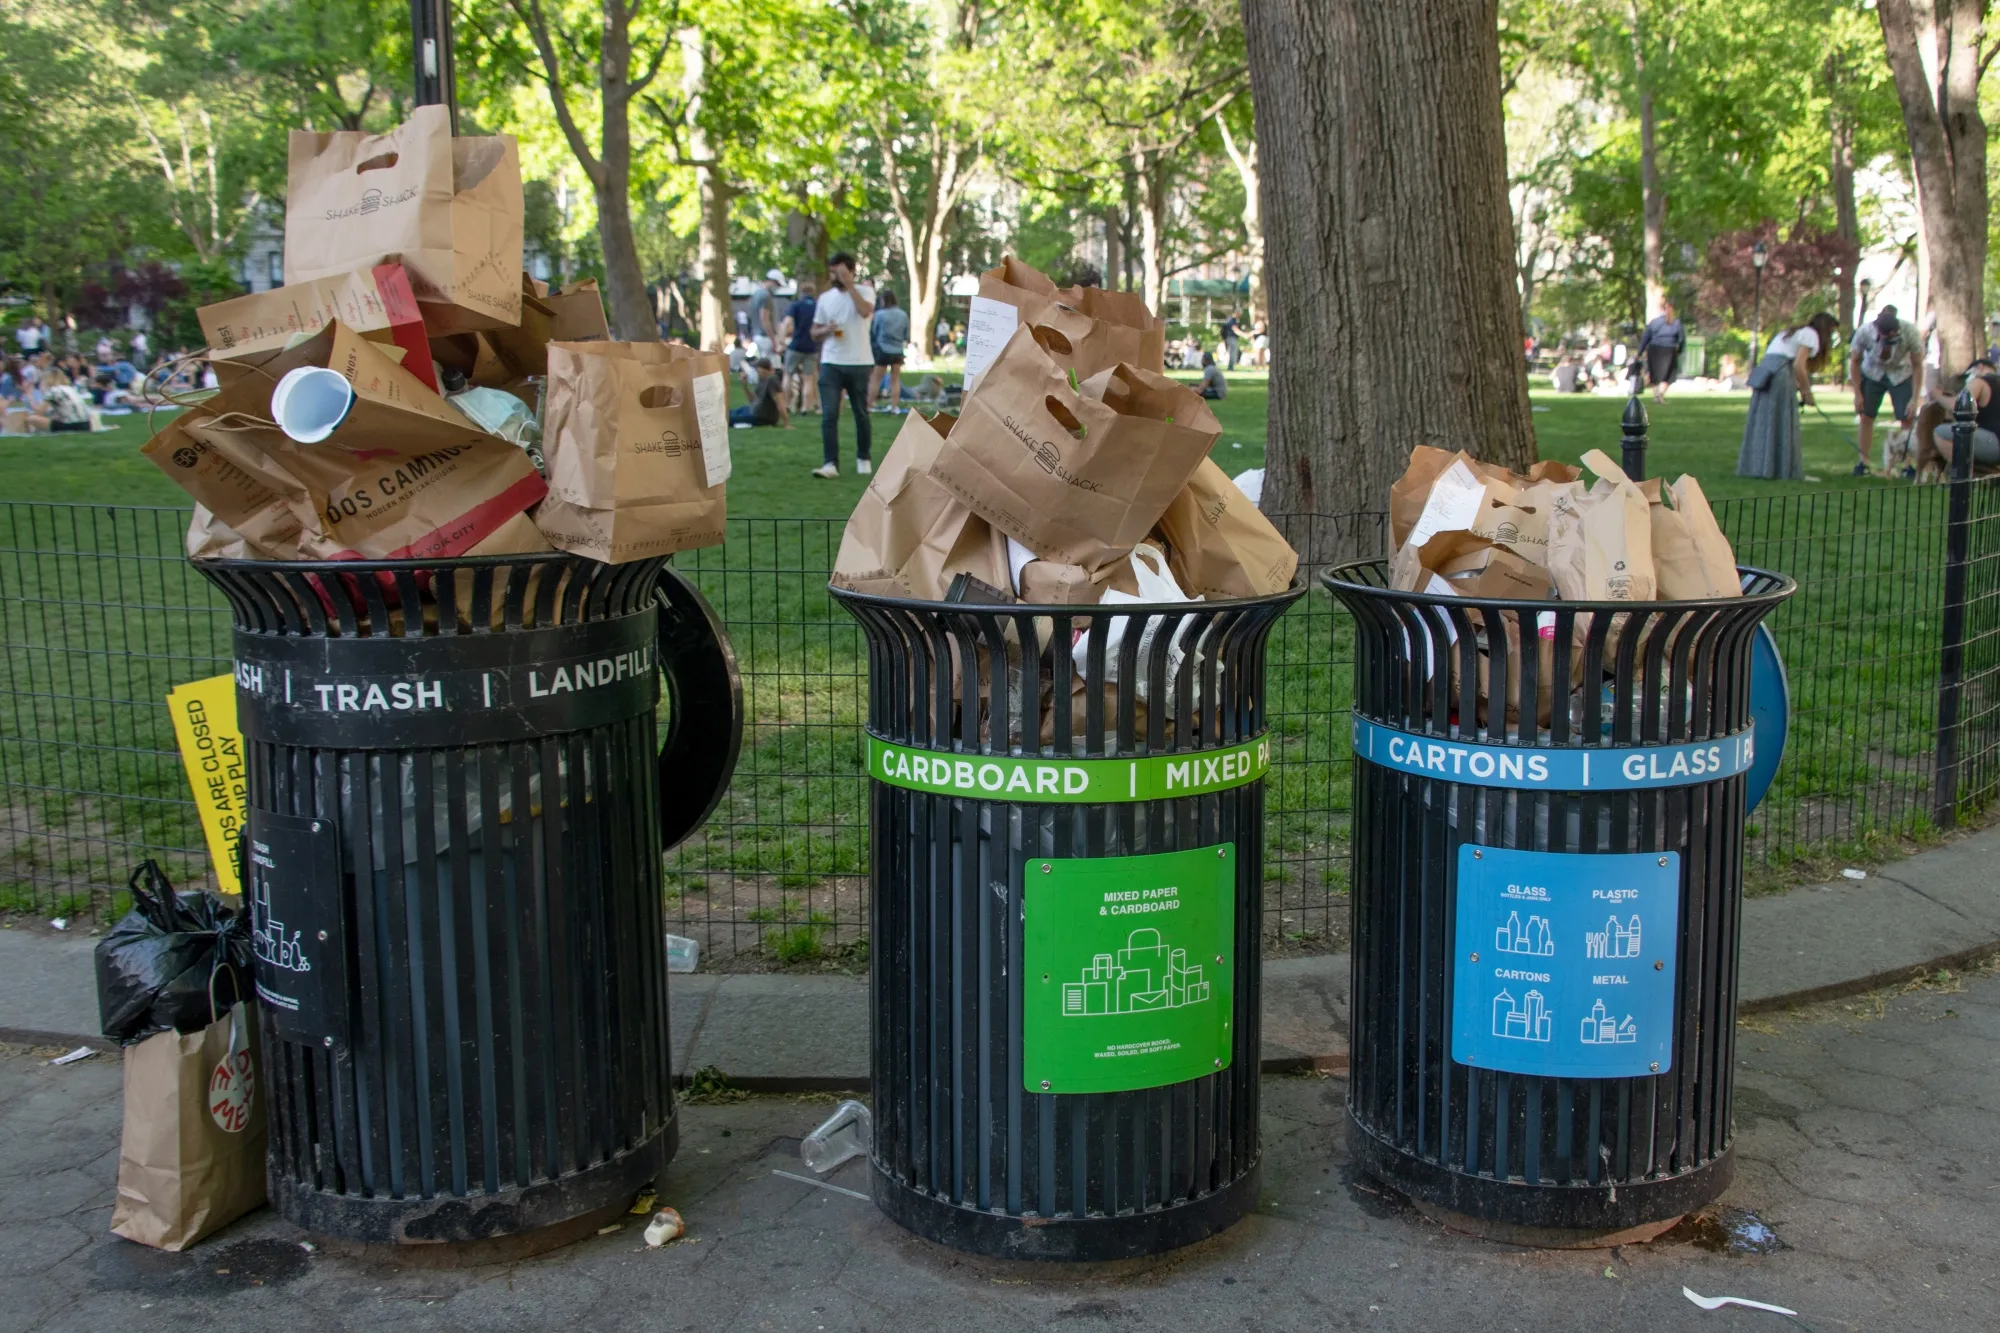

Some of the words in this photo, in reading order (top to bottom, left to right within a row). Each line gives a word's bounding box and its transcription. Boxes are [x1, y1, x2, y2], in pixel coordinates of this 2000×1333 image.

[324, 207, 360, 221] SHAKE
[381, 188, 418, 208] SHACK
[634, 441, 663, 454] SHAKE
[681, 440, 701, 452] SHA
[1003, 415, 1039, 453] SHAKE
[1055, 466, 1100, 493] SHACK
[326, 489, 373, 525] DOS
[366, 501, 397, 520] MODERN
[398, 481, 430, 502] MEXICAN
[429, 463, 458, 485] CUISINE
[426, 537, 451, 554] YORK
[452, 523, 477, 541] CITY
[541, 529, 564, 543] HAKE
[565, 534, 600, 549] SHACK
[1473, 530, 1495, 539] AKE
[1519, 535, 1549, 547] SHAC
[235, 659, 263, 694] ASH
[314, 680, 444, 712] TRASH
[529, 648, 652, 698] LANDFILL
[186, 699, 219, 773] CLOSED
[218, 736, 247, 779] PLAY
[882, 749, 1090, 795] CARDBOARD
[1165, 750, 1250, 790] MIXED
[1388, 737, 1549, 782] CARTONS
[1622, 746, 1720, 782] GLASS
[206, 774, 233, 812] ARE
[1104, 889, 1139, 903] MIXED
[1143, 886, 1178, 900] PAPER
[1507, 884, 1547, 897] GLASS
[1592, 888, 1639, 900] PLASTIC
[1099, 905, 1108, 916] &
[1110, 899, 1180, 916] CARDBOARD
[1494, 968, 1551, 983] CARTONS
[1592, 975, 1630, 985] METAL
